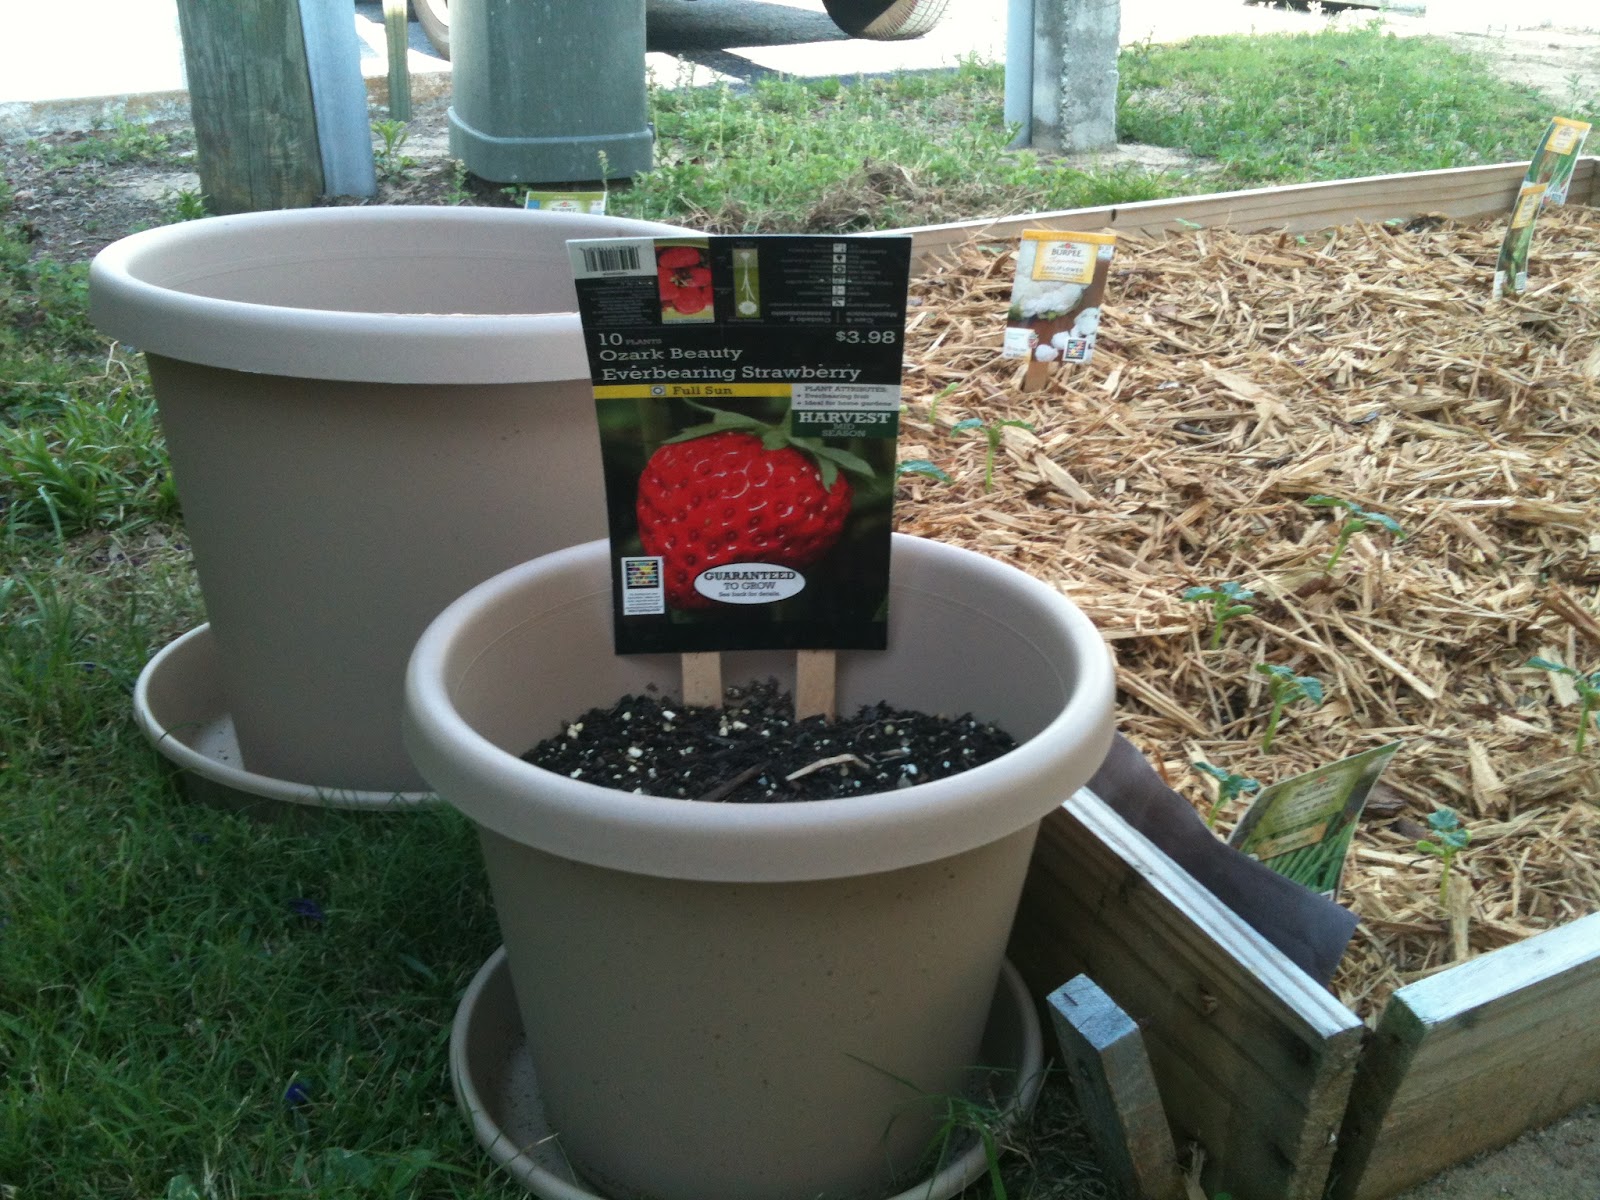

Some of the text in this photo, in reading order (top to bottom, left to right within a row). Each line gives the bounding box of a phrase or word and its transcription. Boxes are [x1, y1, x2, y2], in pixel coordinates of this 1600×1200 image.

[1051, 248, 1083, 257] BURPEE
[599, 333, 622, 346] 10
[835, 330, 896, 344] $3.98
[600, 347, 743, 362] Ozark Beauty
[602, 365, 862, 382] Everbearing Strawberry
[673, 386, 733, 396] Full Sun
[798, 412, 891, 424] HARVEST
[704, 571, 797, 581] GUARANTEED
[723, 581, 777, 590] TO GROW
